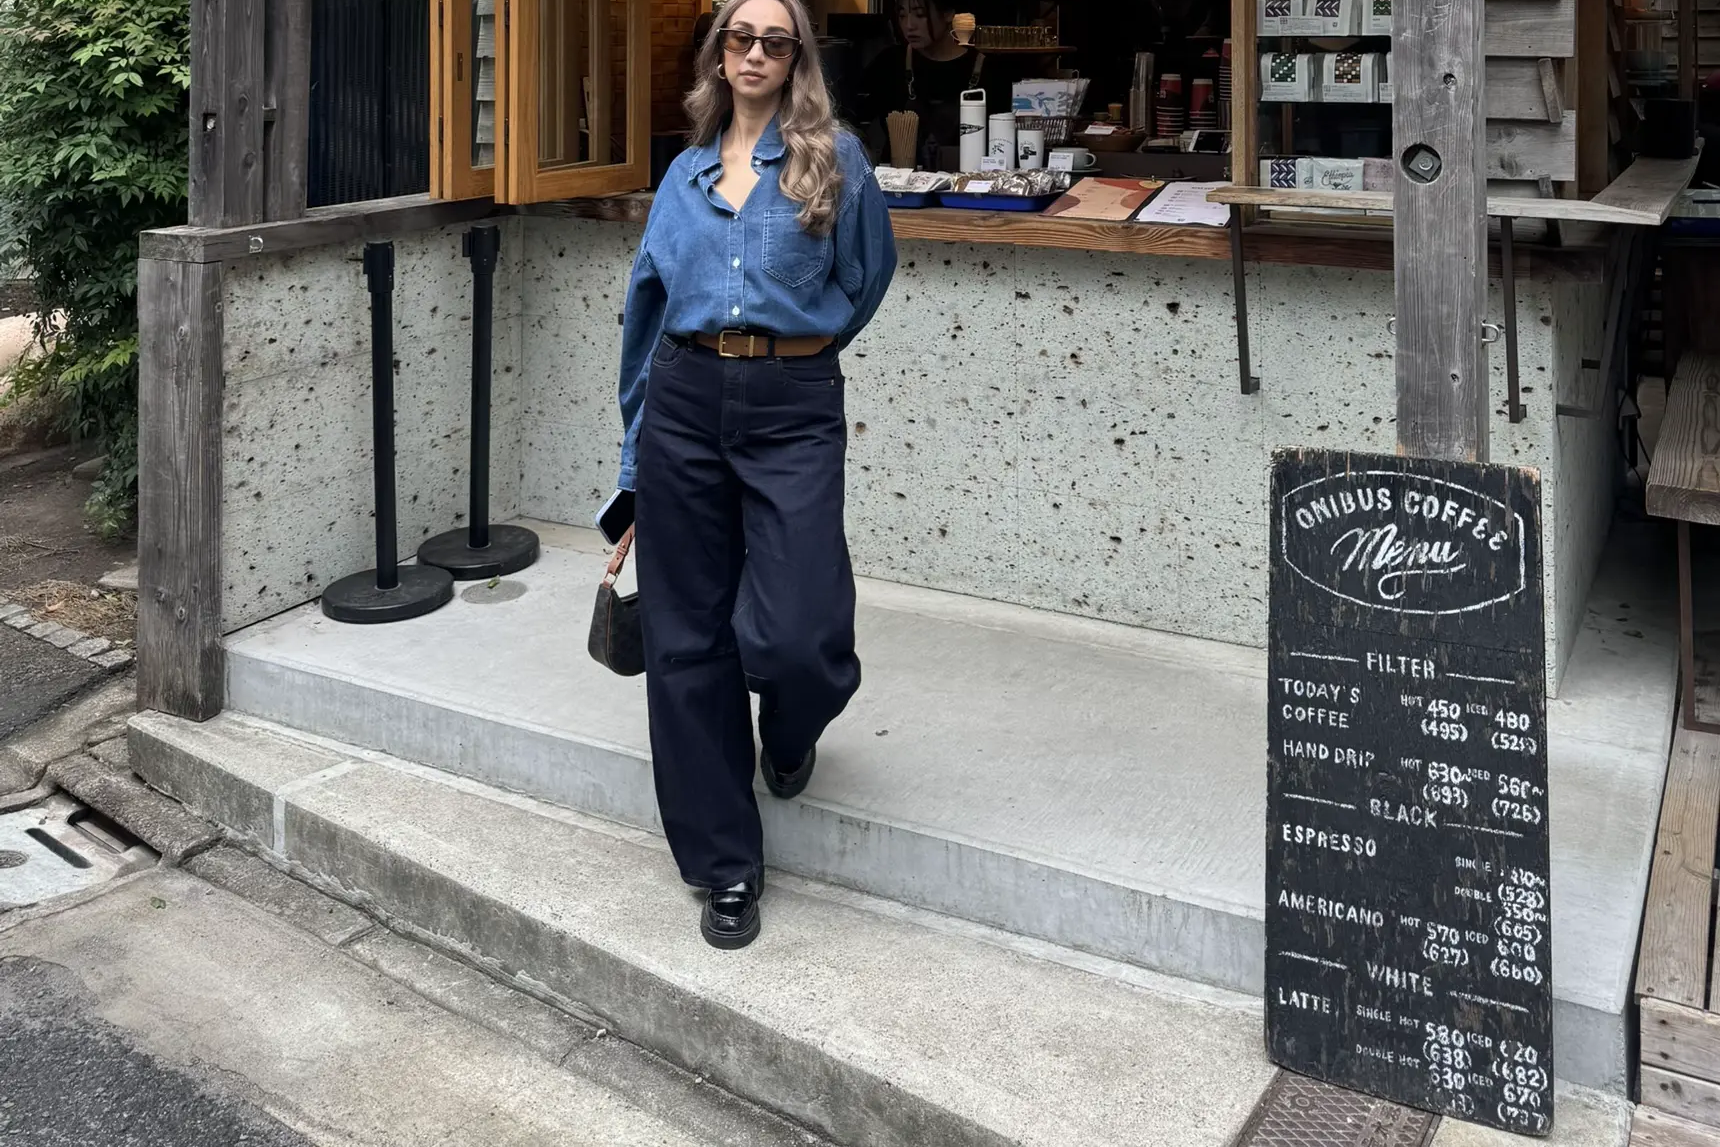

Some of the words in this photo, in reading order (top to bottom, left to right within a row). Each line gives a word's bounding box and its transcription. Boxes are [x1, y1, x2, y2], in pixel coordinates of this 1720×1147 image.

[1295, 487, 1392, 529] ONIBUS
[1404, 490, 1509, 551] COFFEE
[1331, 523, 1466, 575] Menu
[1366, 652, 1436, 680] FILTER
[1278, 677, 1361, 703] TODAY'S
[1282, 704, 1351, 729] COFFEE
[1400, 694, 1423, 708] HOT
[1426, 699, 1461, 719] 450
[1466, 703, 1489, 715] ICED
[1494, 708, 1530, 732] 480
[1282, 740, 1329, 762] HAND
[1400, 757, 1423, 771] HOT
[1468, 768, 1491, 781] ICED
[1369, 798, 1437, 828] BLACK
[1282, 824, 1377, 858] ESPRESSO
[1278, 889, 1384, 928] AMERICANO
[1400, 915, 1421, 928] HOT
[1426, 921, 1460, 945] 570
[1465, 930, 1489, 944] ICED
[1366, 960, 1434, 996] WHITE
[1278, 987, 1331, 1014] LATTE
[1399, 1015, 1421, 1029] HOT
[1425, 1022, 1465, 1048] 580
[1467, 1031, 1493, 1048] ICED
